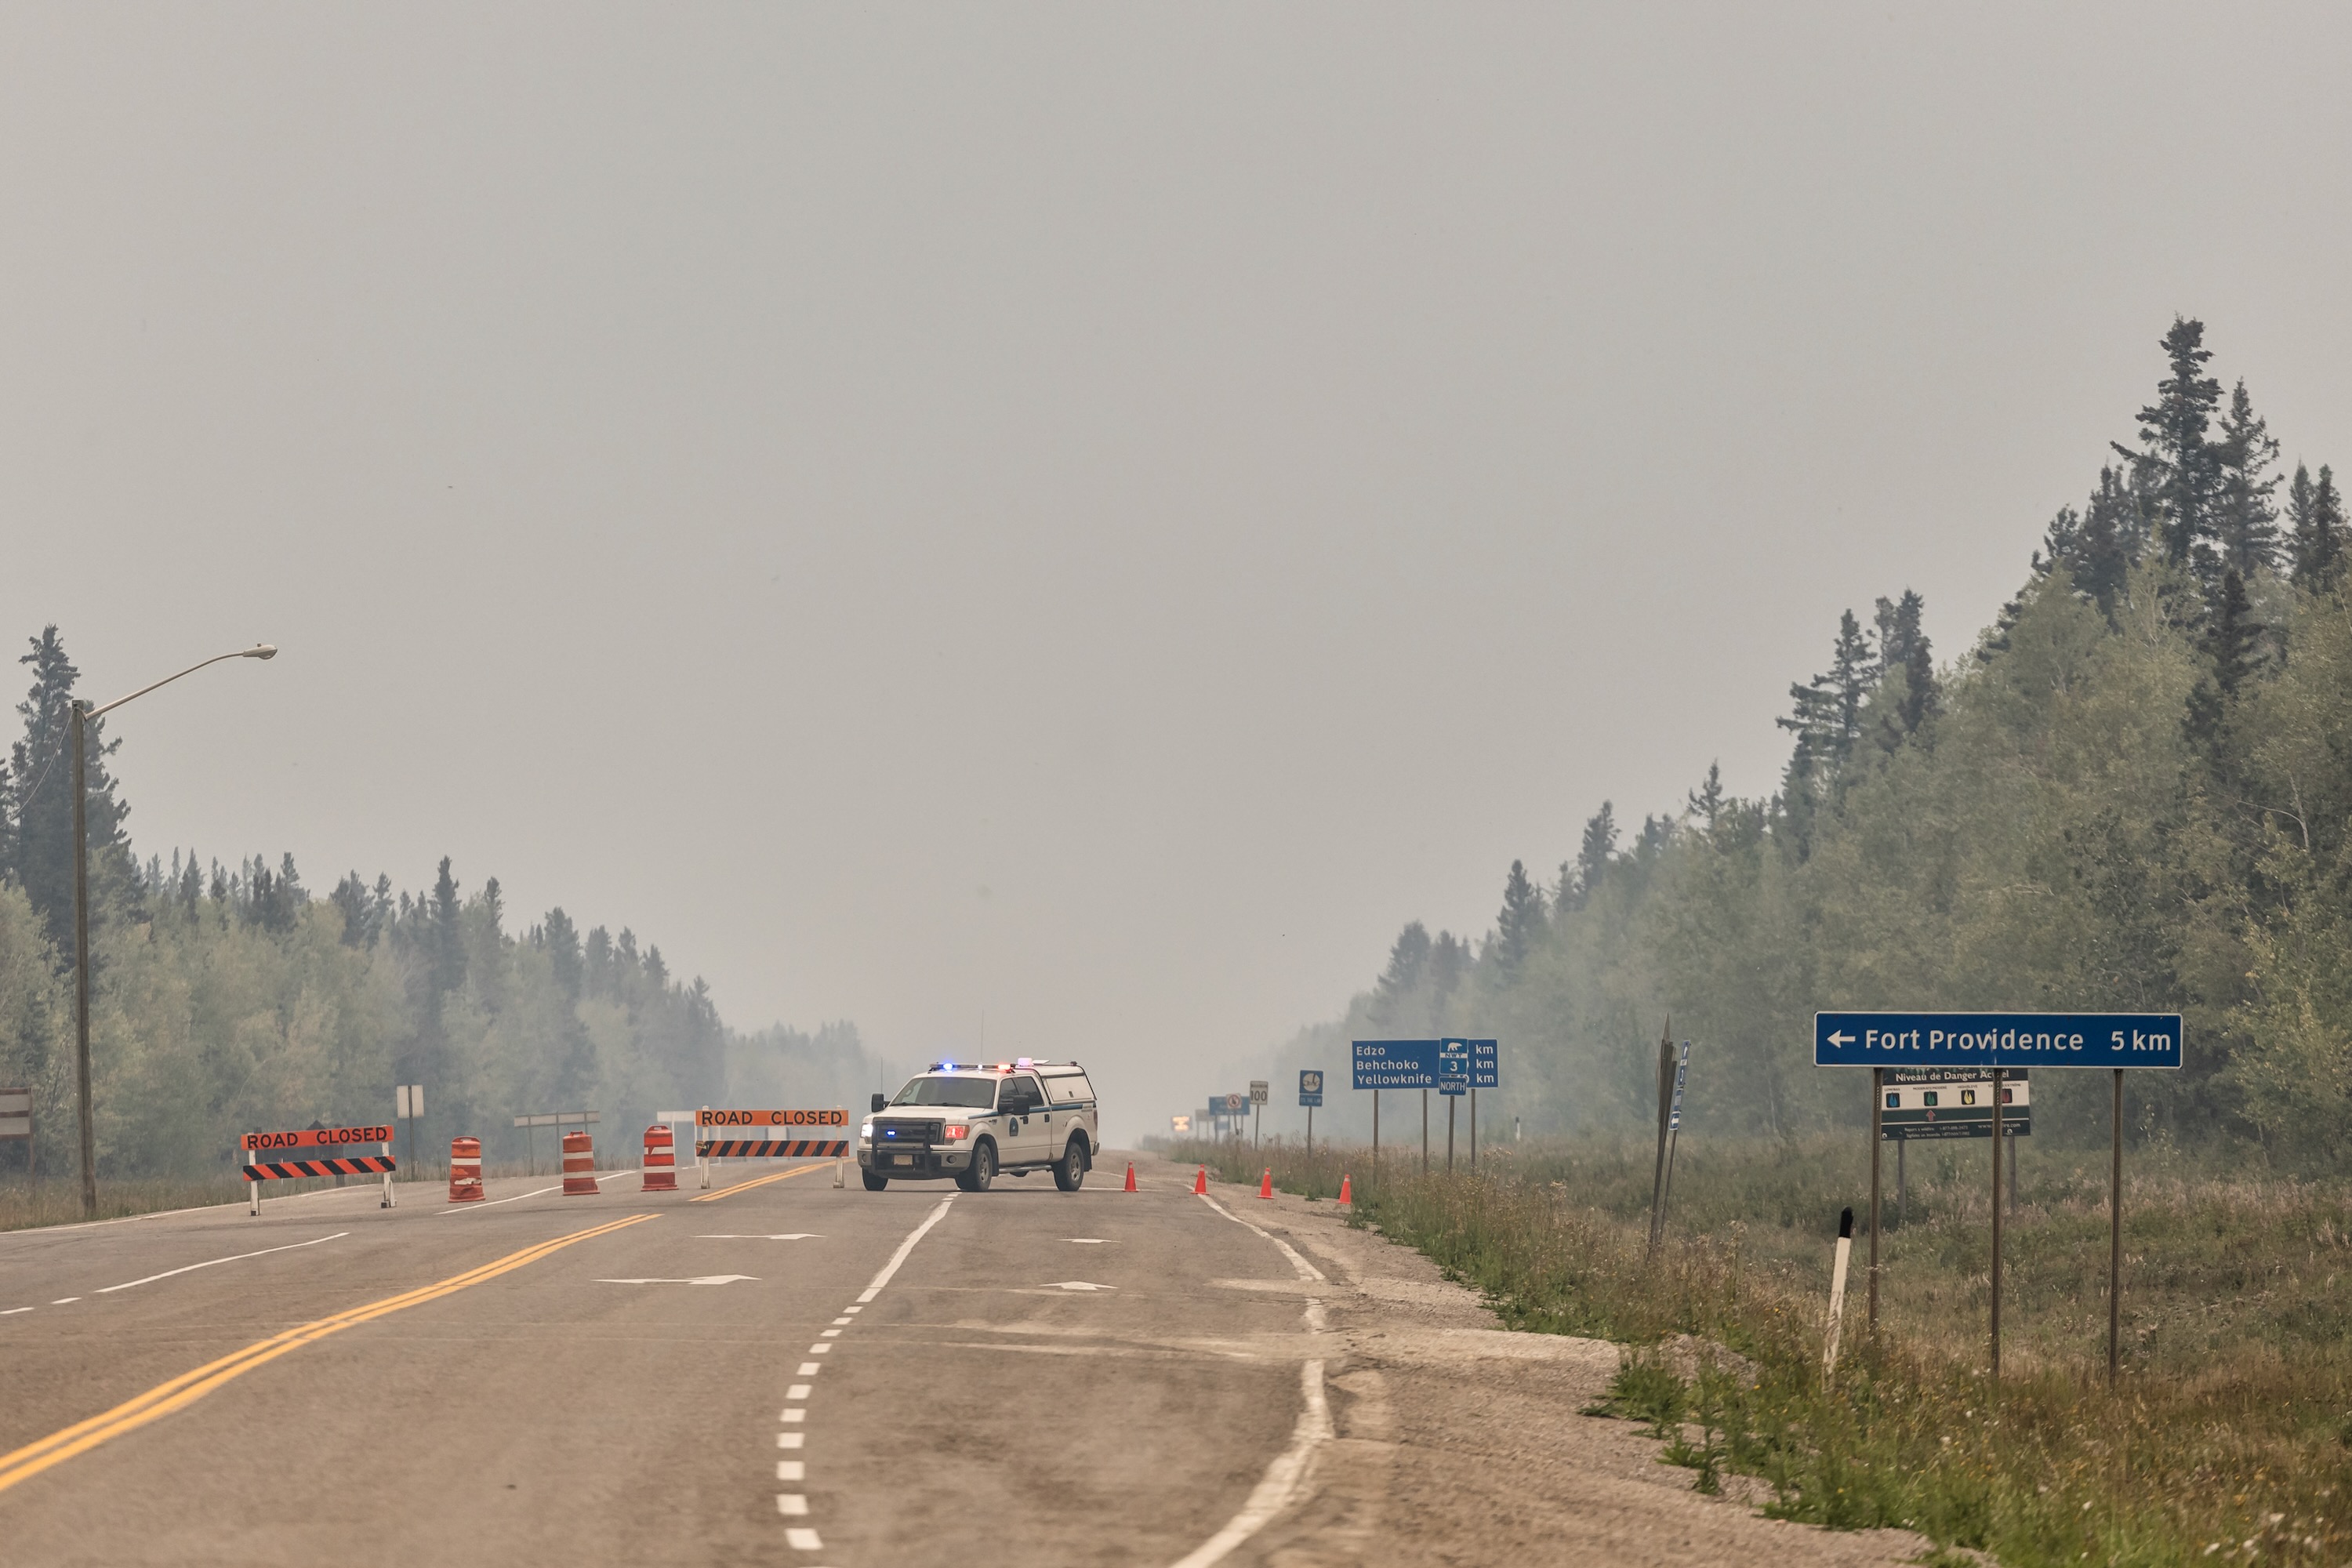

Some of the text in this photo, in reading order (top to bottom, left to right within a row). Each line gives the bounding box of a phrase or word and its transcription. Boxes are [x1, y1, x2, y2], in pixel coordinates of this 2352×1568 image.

[1865, 1028, 2171, 1051] Fort Providence 5 km
[1356, 1044, 1494, 1056] Edzo km
[1356, 1060, 1419, 1070] Behchoko
[1475, 1058, 1494, 1069] km
[1450, 1061, 1458, 1072] 3
[1357, 1073, 1432, 1084] Yellowknife
[1476, 1073, 1494, 1083] km
[1895, 1069, 2009, 1082] Niveau de Danger Acel
[1440, 1081, 1465, 1091] NORTH
[1250, 1090, 1267, 1102] 100
[702, 1111, 842, 1125] ROAD CLOSED
[247, 1127, 387, 1149] ROAD CLOSED
